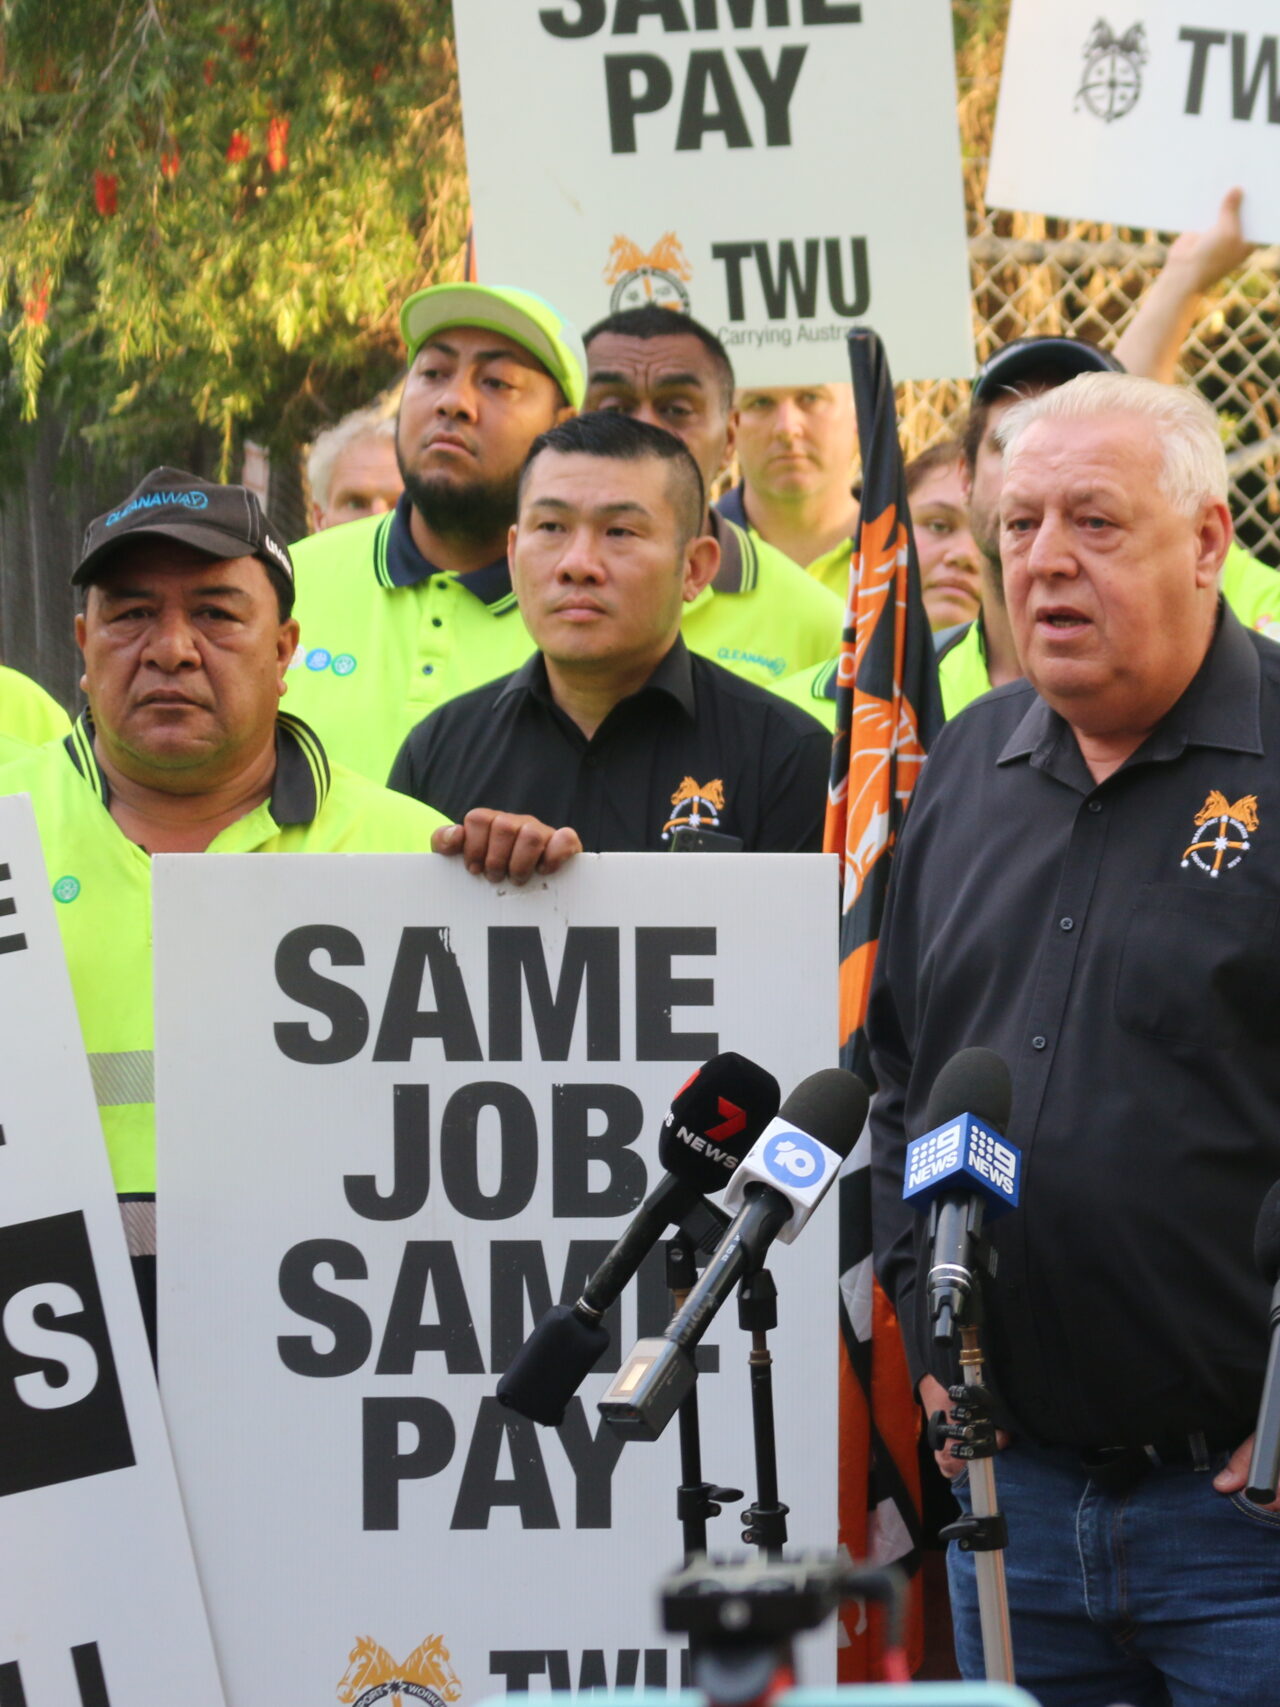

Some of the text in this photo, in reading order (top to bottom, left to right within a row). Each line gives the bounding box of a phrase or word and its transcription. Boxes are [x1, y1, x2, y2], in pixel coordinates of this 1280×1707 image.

[603, 44, 809, 153] PAY
[712, 236, 870, 322] TWU
[717, 322, 852, 347] Carrying Austr
[273, 923, 719, 1064] SAME
[343, 1080, 648, 1221] JOB
[676, 1125, 739, 1170] NEWS
[936, 1124, 960, 1159] 9
[994, 1141, 1016, 1180] 9
[908, 1150, 959, 1189] NEWS
[968, 1152, 1014, 1195] NEWS
[362, 1395, 634, 1531] PAY
